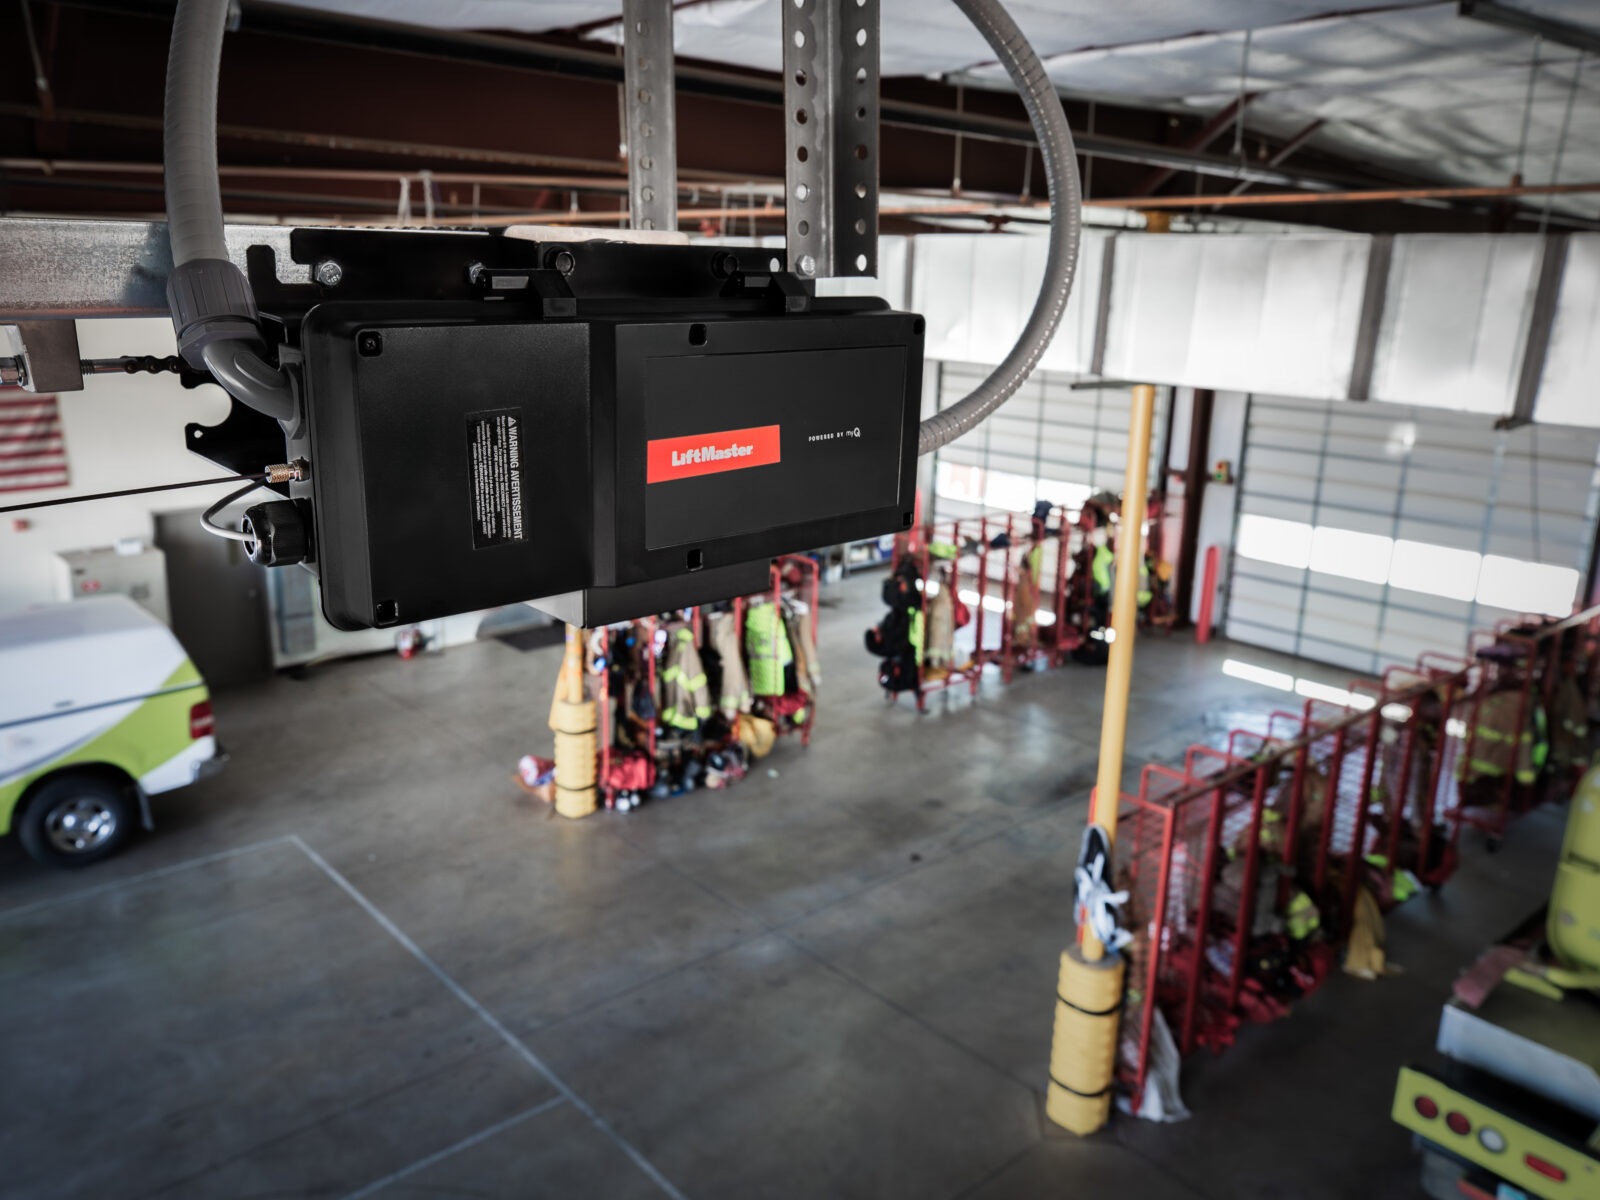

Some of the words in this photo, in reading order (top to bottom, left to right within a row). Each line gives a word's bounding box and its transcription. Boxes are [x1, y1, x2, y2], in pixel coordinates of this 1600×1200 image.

[508, 426, 519, 468] WARNING
[808, 433, 834, 442] POWERED
[845, 427, 861, 438] myQ
[671, 443, 754, 467] LiftMaster
[511, 469, 522, 539] AVERTISSEMENT
